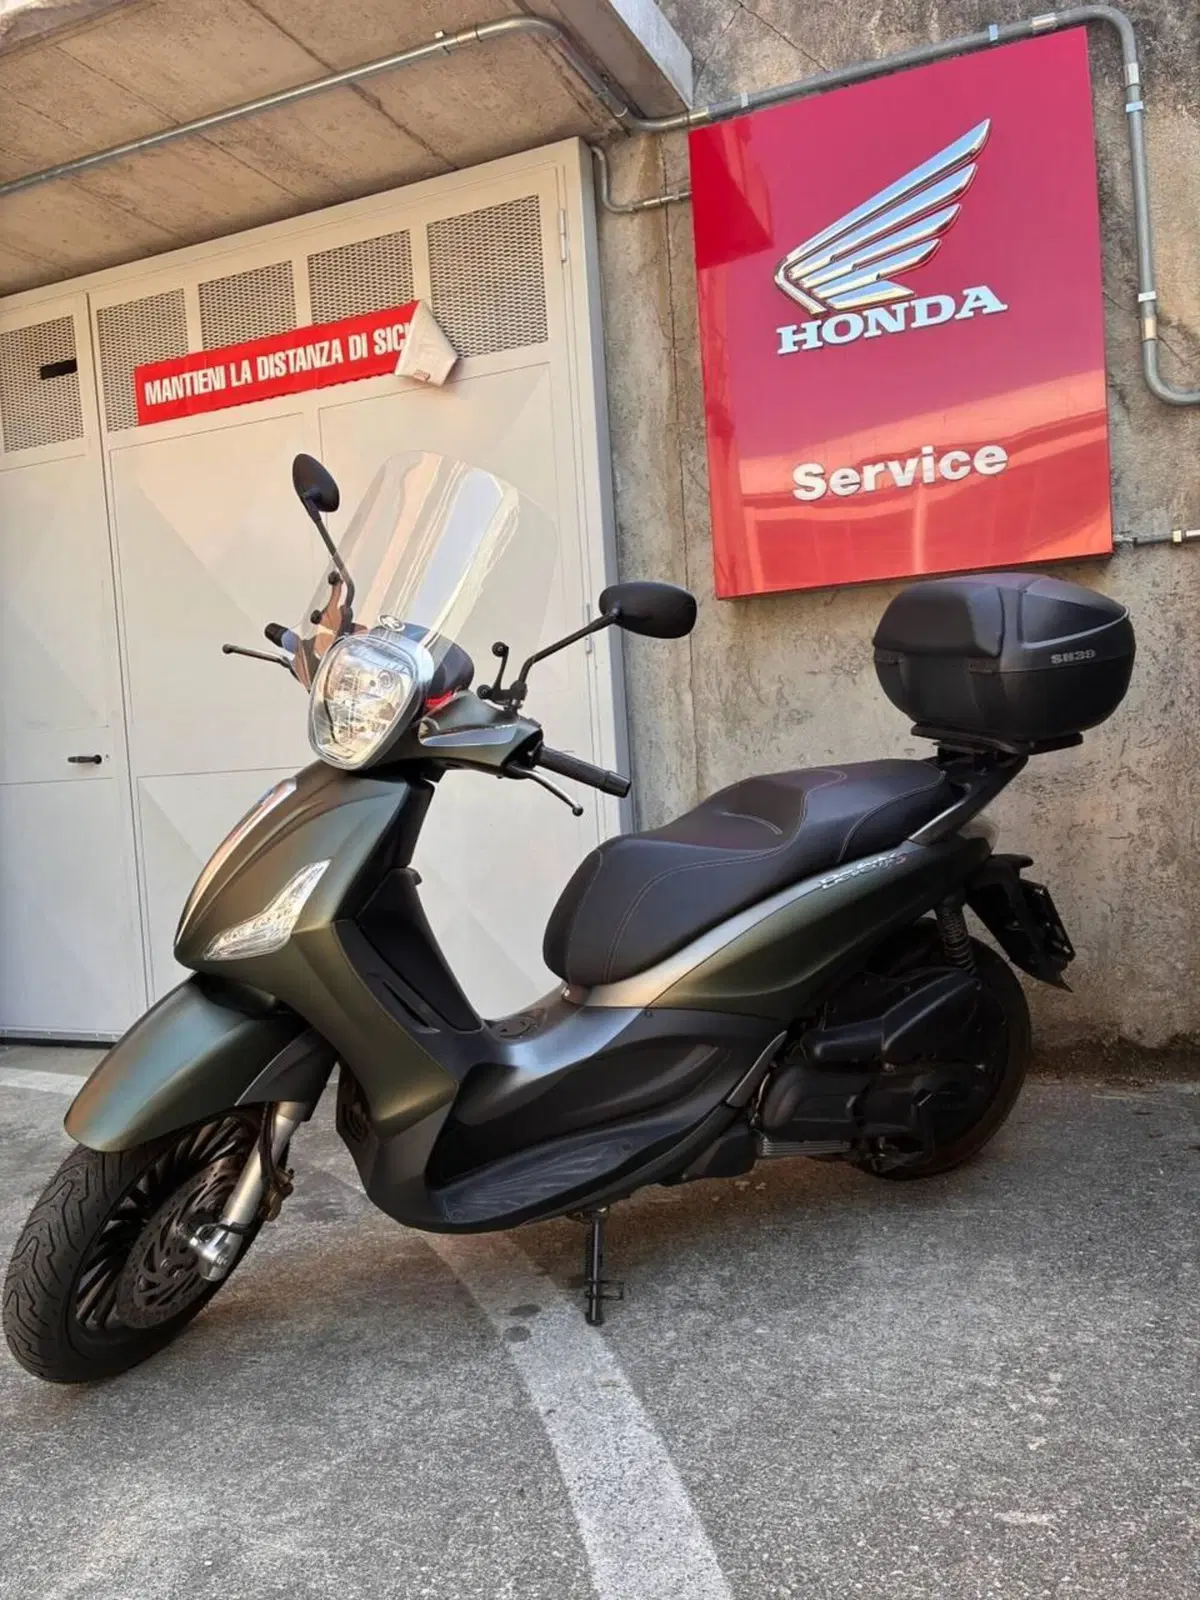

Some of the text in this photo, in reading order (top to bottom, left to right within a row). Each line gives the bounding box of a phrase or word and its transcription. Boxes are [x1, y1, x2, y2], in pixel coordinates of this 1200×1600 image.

[776, 285, 1009, 355] HONDA
[145, 365, 227, 406] MANTIENI
[230, 357, 253, 386] LA
[257, 339, 344, 381] DISTANZA
[348, 334, 369, 360] DI
[792, 445, 1009, 501] Service
